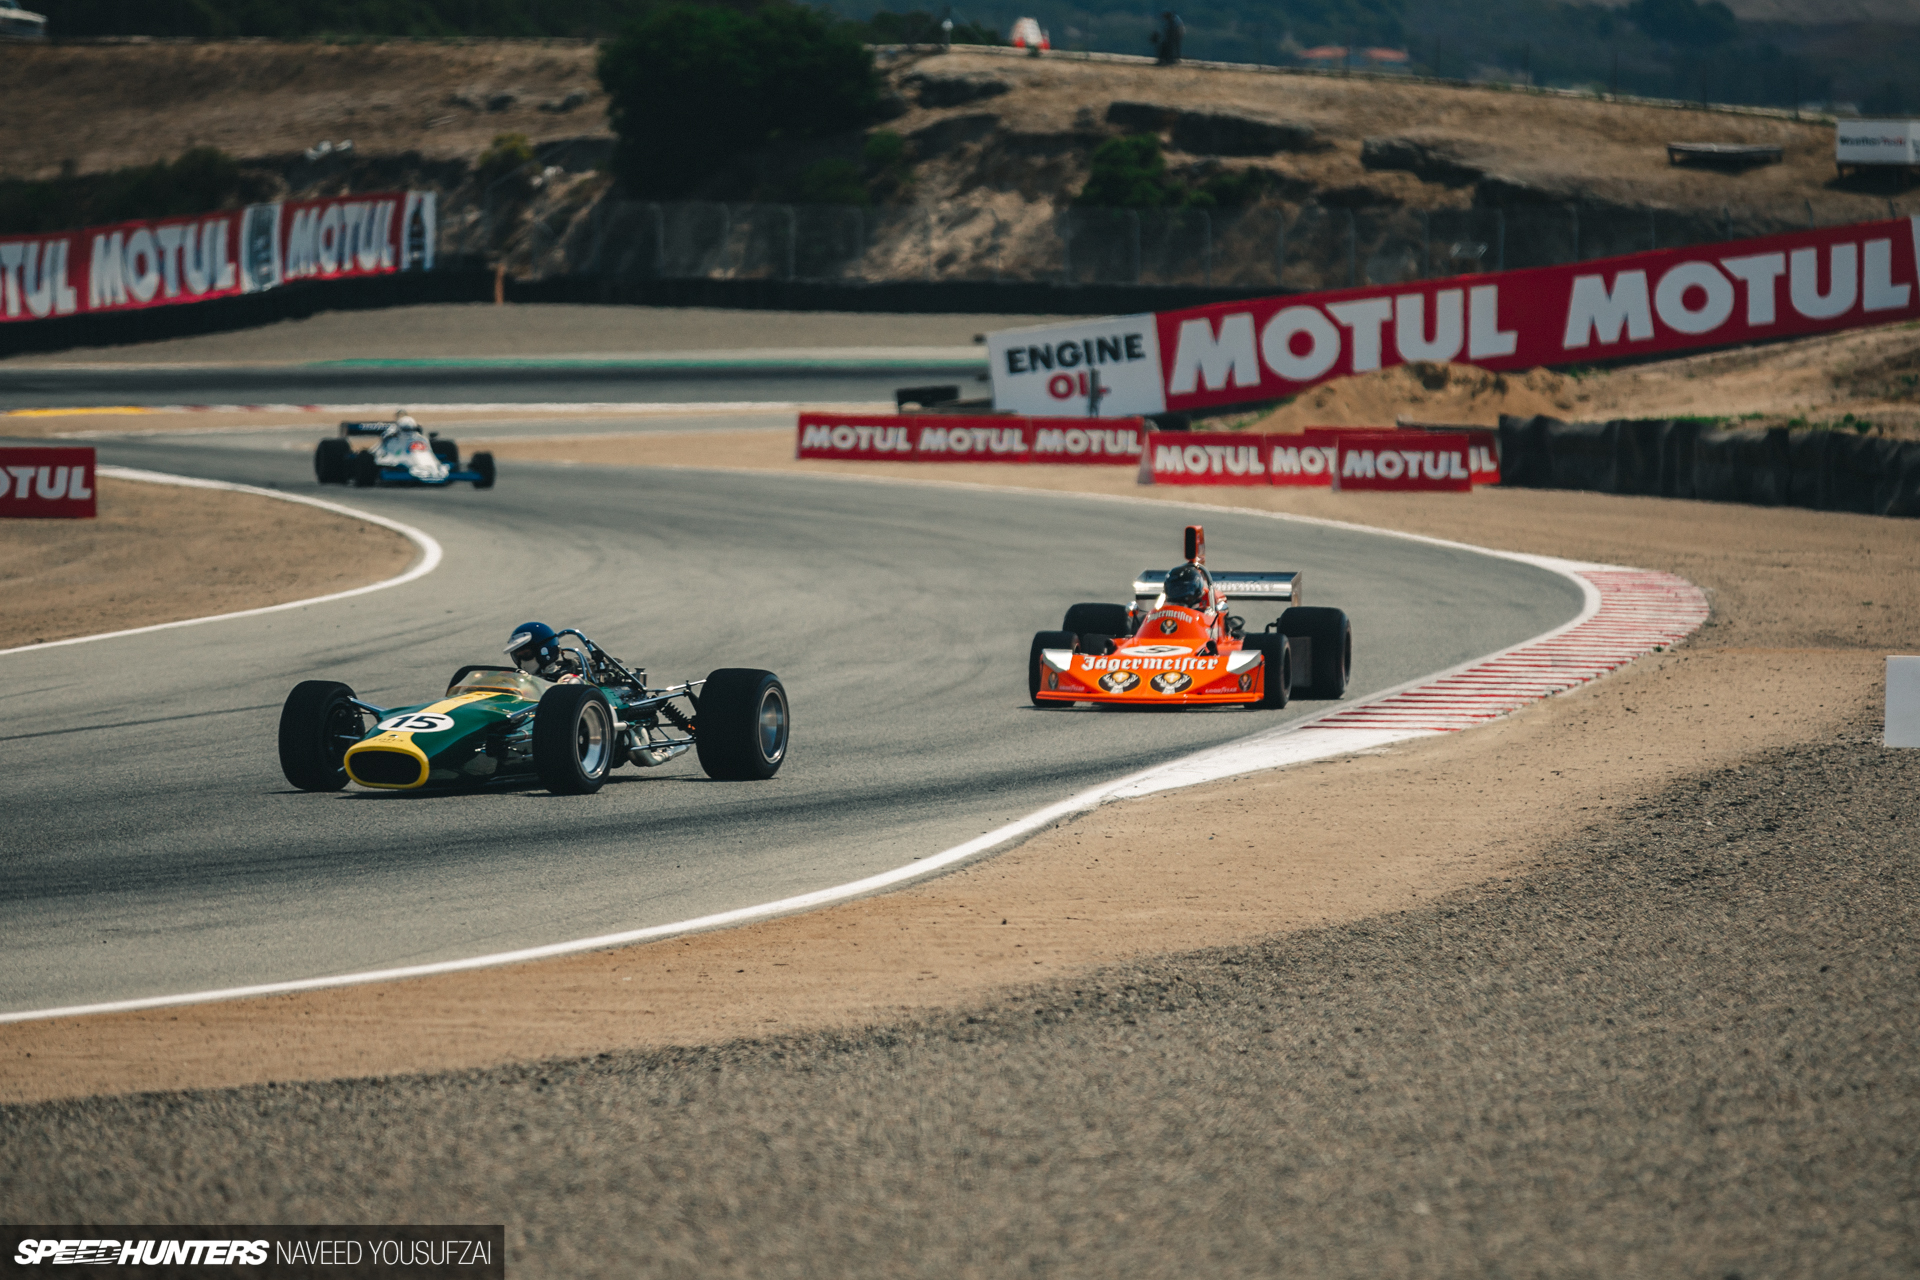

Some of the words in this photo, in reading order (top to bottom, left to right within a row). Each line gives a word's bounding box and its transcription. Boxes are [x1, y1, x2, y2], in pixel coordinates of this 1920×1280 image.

[89, 219, 236, 308] MOTUL
[286, 201, 396, 278] MOTUL
[1169, 284, 1518, 396] MOTUL
[1563, 238, 1911, 349] MOTUL
[1006, 333, 1146, 374] ENGINE
[802, 425, 912, 452] MOTUL
[919, 427, 1028, 453] MOTUL
[1035, 428, 1143, 456] MOTUL
[1155, 445, 1265, 474] MOTUL
[1342, 450, 1469, 480] MOTUL
[389, 715, 447, 730] 15
